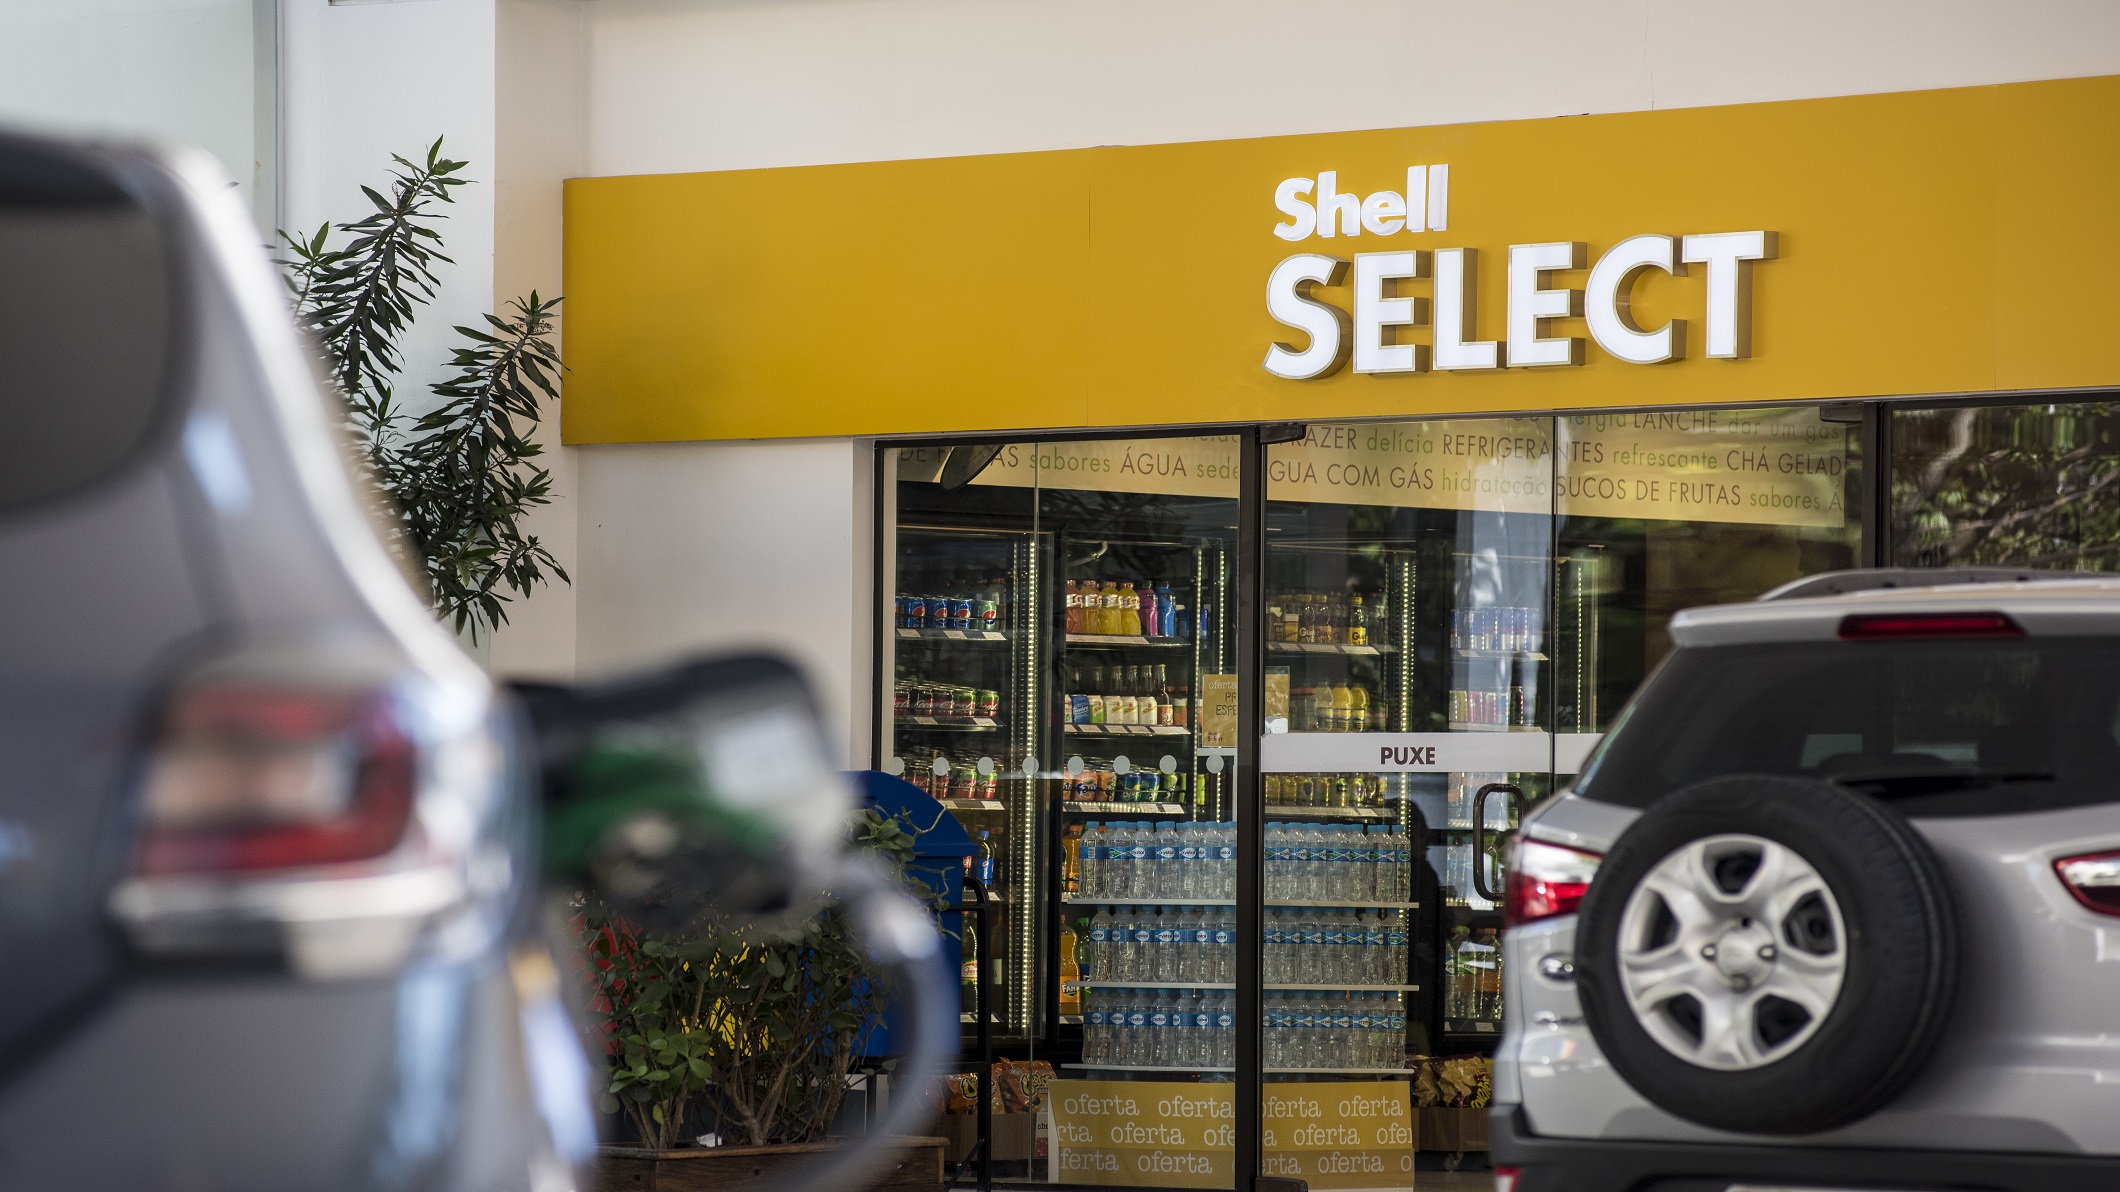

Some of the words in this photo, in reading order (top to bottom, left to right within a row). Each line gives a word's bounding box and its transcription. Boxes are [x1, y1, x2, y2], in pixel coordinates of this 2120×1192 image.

[1273, 163, 1449, 241] Shell
[1262, 230, 1772, 380] SELECT
[1634, 411, 1718, 433] LANCHE
[1028, 450, 1111, 473] sabores
[1120, 446, 1188, 477] ÁGUA
[1280, 425, 1358, 450] AZER
[1366, 429, 1434, 454] delícia
[1613, 443, 1718, 470] refrescante
[1727, 446, 1770, 473] CHÁ
[1778, 453, 1842, 476] GELAD
[1326, 463, 1381, 487] COM
[1389, 462, 1434, 490] GÁS
[1442, 468, 1547, 499] hidratação
[1556, 475, 1627, 500] SUCOS
[1636, 480, 1660, 501] DE
[1669, 482, 1741, 506] FRUTAS
[1750, 485, 1821, 510] sabores
[1380, 747, 1436, 765] PUXE
[1064, 1093, 1140, 1116] oferta
[1157, 1095, 1236, 1118] oferta
[1338, 1095, 1404, 1117] oferta
[1110, 1122, 1185, 1145] oferta
[1293, 1123, 1361, 1146] oferta
[1060, 1148, 1120, 1172] ferta
[1137, 1150, 1213, 1174] oferta
[1317, 1151, 1385, 1173] oferta
